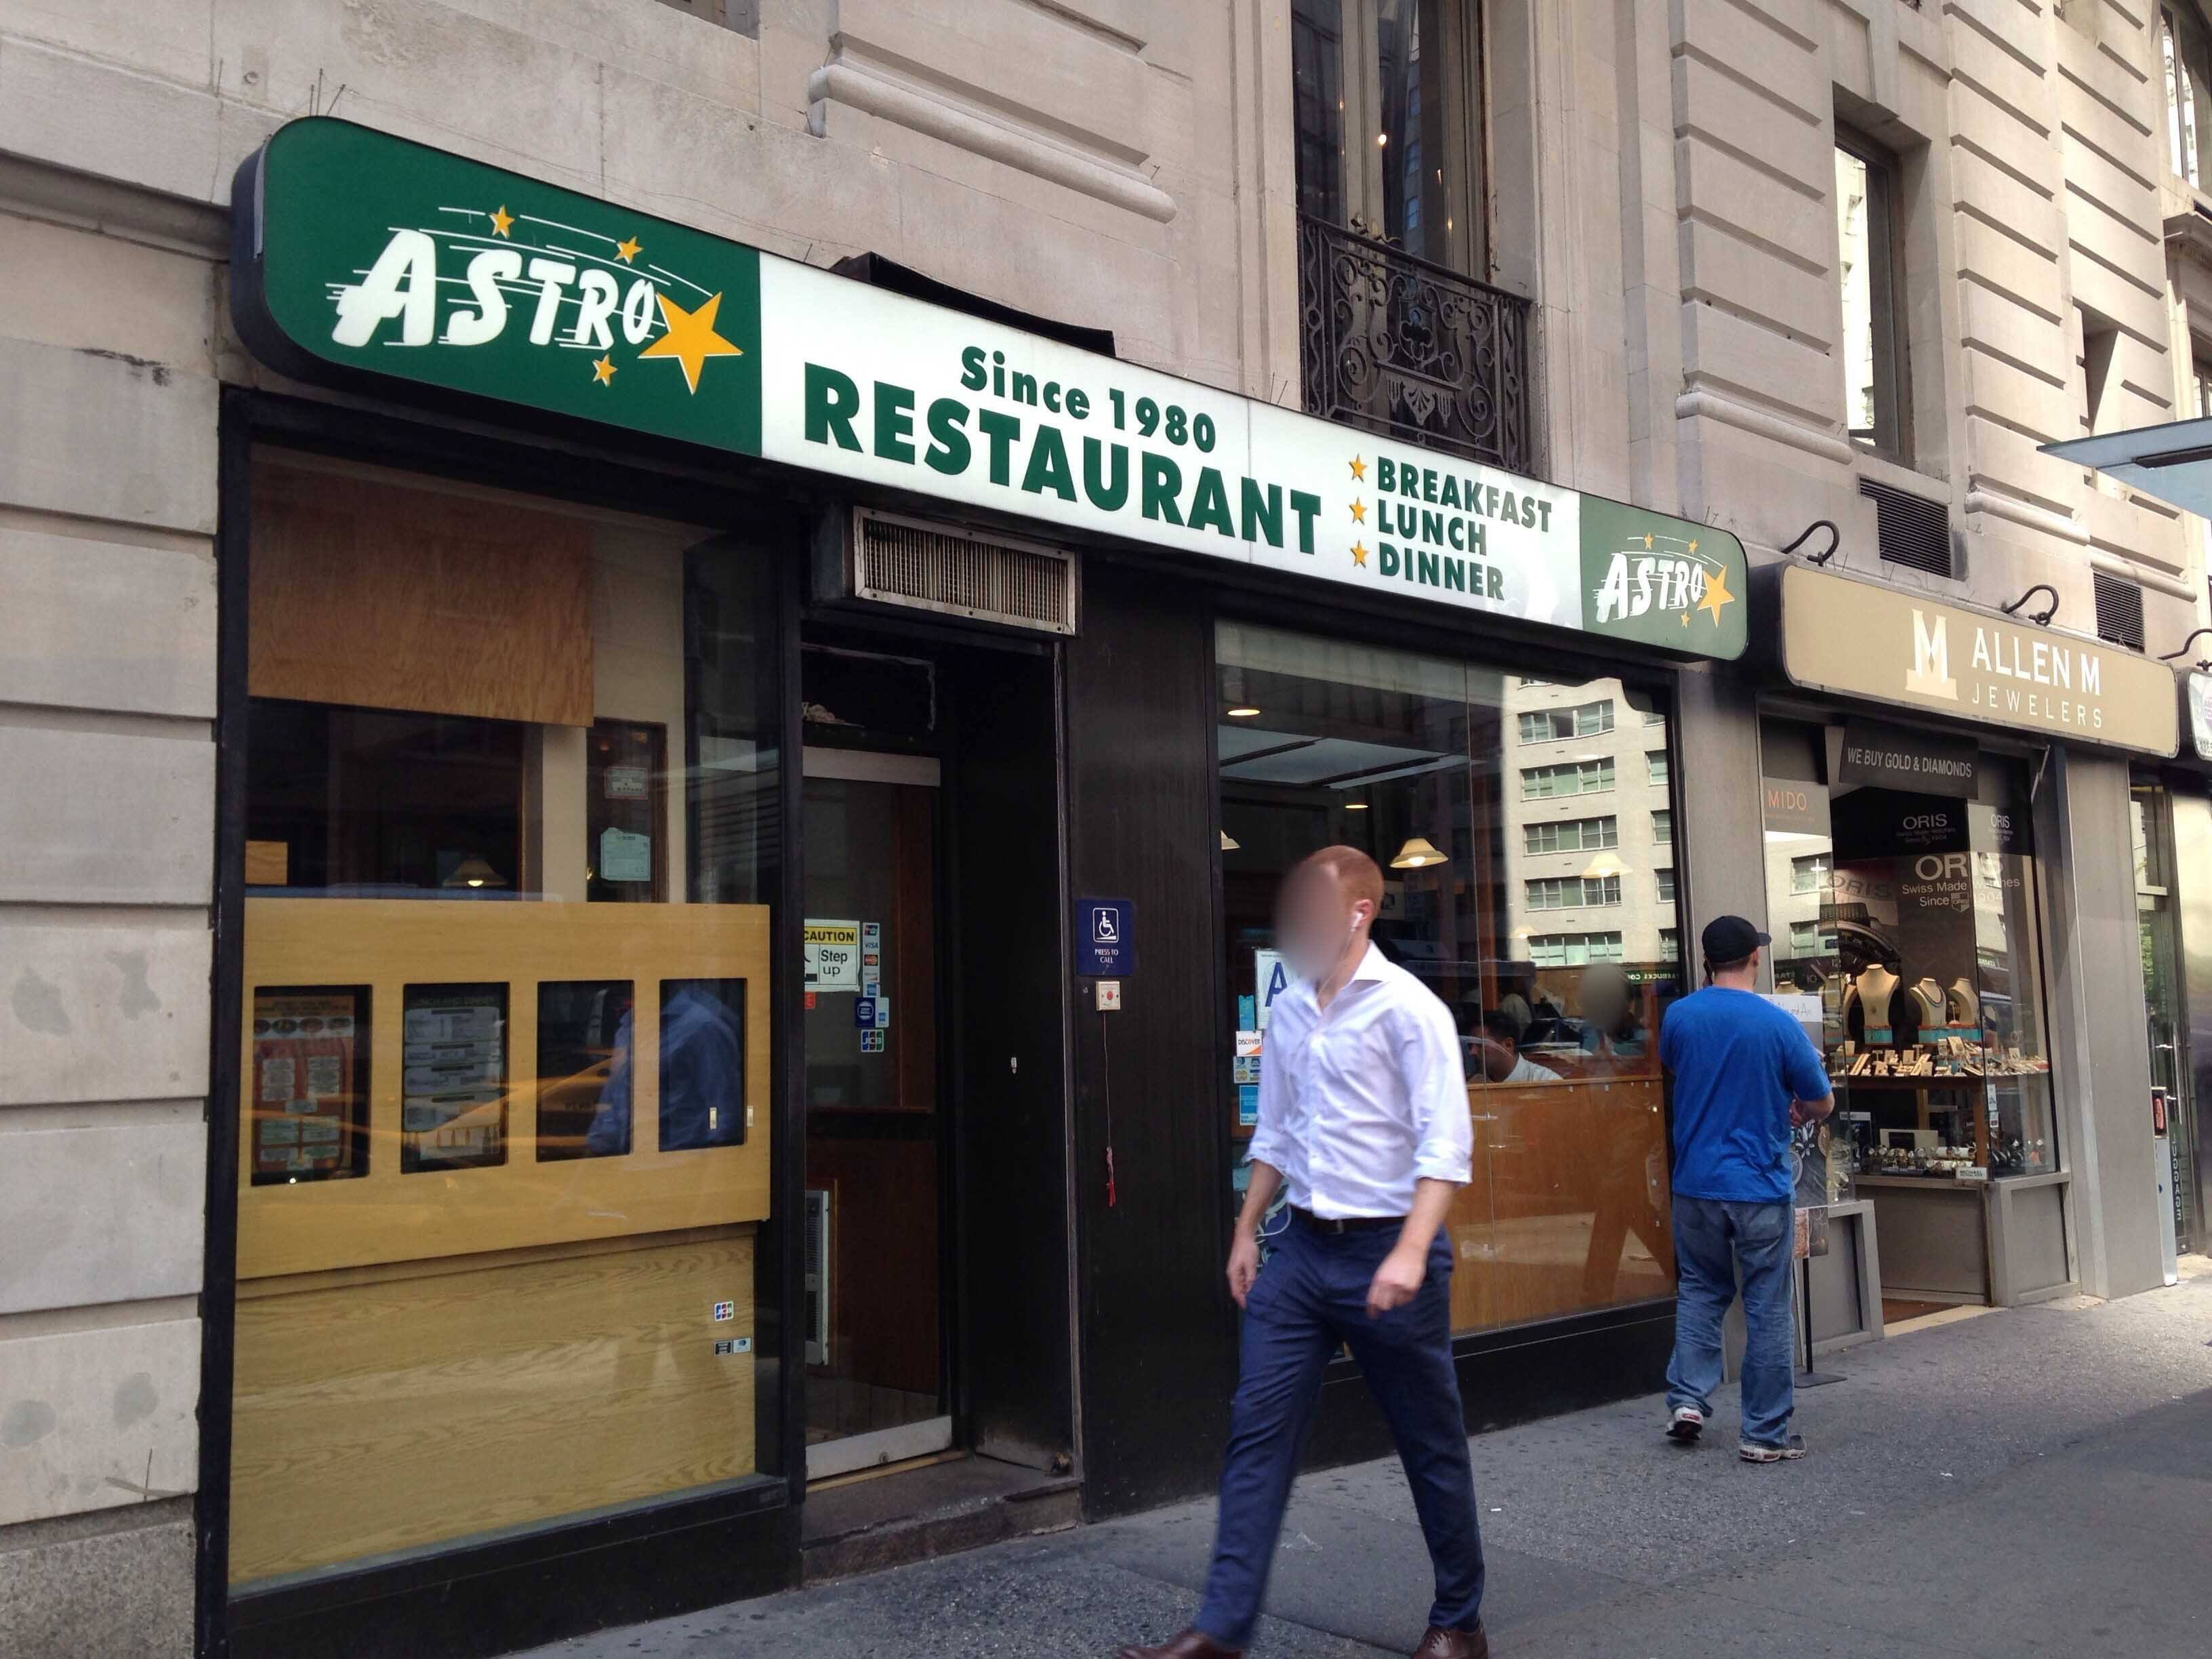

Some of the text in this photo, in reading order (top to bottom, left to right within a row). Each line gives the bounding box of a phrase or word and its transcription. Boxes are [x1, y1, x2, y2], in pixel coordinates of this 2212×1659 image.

[331, 229, 655, 348] ASTRO
[961, 346, 1216, 453] Since 1980
[805, 362, 1322, 555] RESTAURANT
[1378, 456, 1552, 533] BREAKFAST
[1378, 499, 1487, 556] LUNCH
[1379, 542, 1504, 601] DINNER
[1595, 553, 1703, 623] ASTRO
[1971, 627, 2101, 695] ALLEN M
[1972, 682, 2102, 728] JEWELERS
[1847, 747, 1972, 778] WE BUY GOLD & DIAMONDS
[1767, 790, 1807, 811] MIDO
[1903, 813, 1948, 830] ORIS
[1990, 814, 2010, 828] ORIS
[1902, 878, 2020, 895] Swiss Made Wahes
[1919, 896, 1950, 907] Since
[804, 930, 854, 942] CAUTION
[821, 950, 848, 964] Step
[823, 966, 841, 977] up
[1265, 962, 1288, 1007] A
